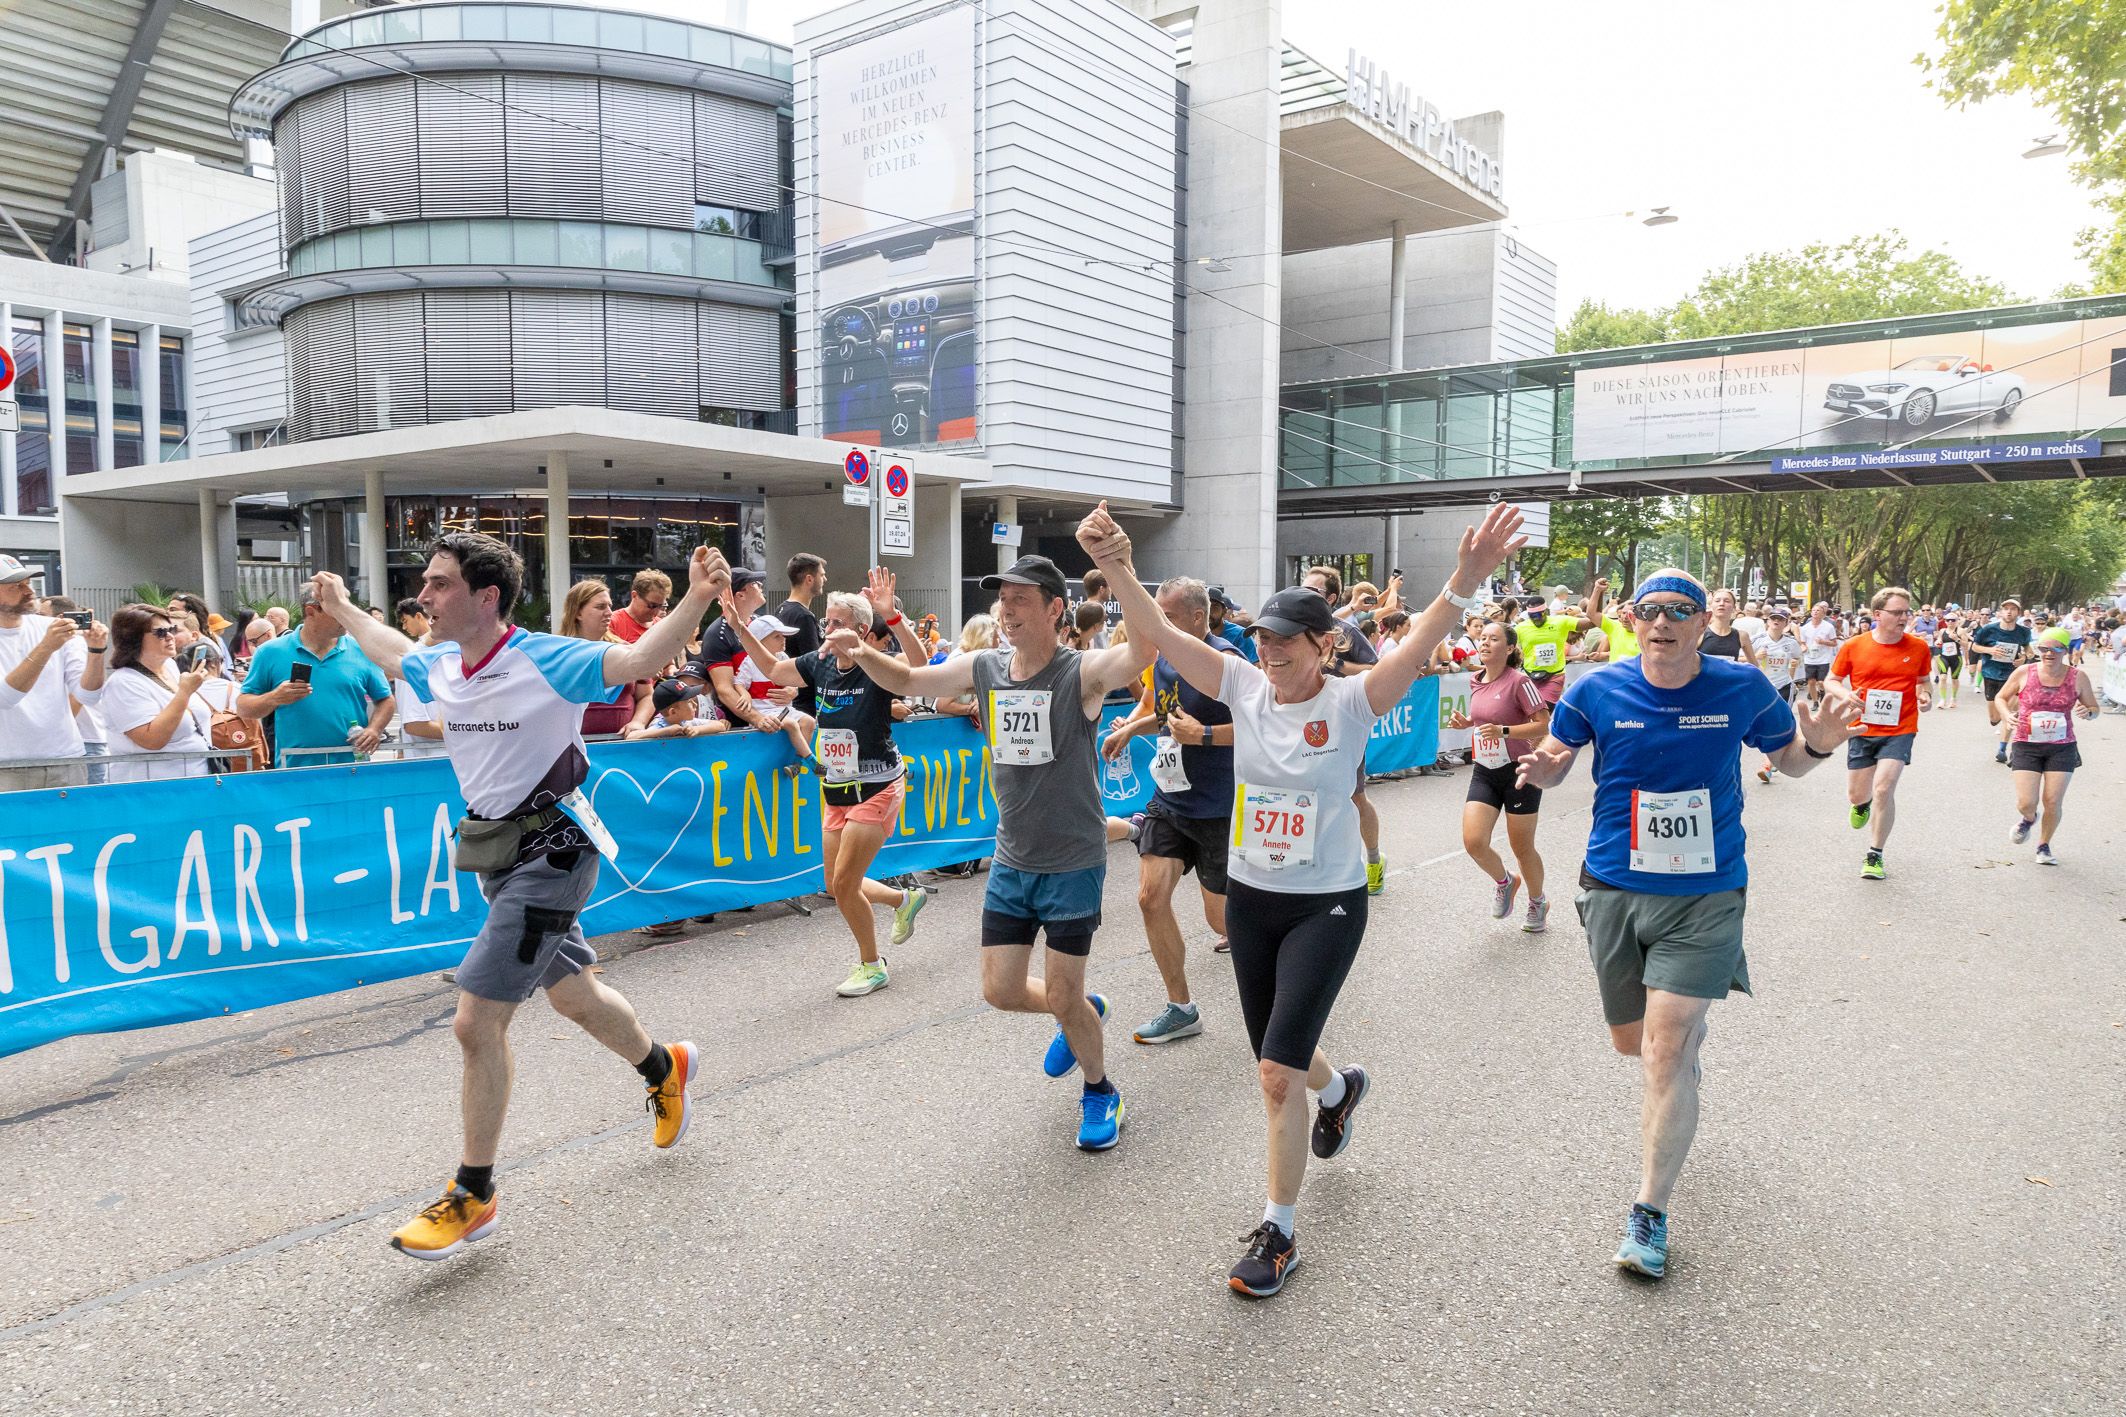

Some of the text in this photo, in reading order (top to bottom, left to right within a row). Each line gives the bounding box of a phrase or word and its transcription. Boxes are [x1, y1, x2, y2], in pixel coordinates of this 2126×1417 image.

[861, 49, 925, 84] HERZLICH
[849, 64, 938, 105] WILLKOMMEN
[861, 90, 927, 122] IM NEUEN
[841, 102, 949, 147] MERCEDES-BENZ
[862, 130, 926, 161] BUSINESS
[1438, 116, 1503, 198] Arena
[867, 152, 921, 178] CENTER.
[1593, 362, 1801, 393] DIESE SAISON ORIENTIEREN
[1616, 381, 1773, 406] WIR UNS NACH OBEN.
[1781, 454, 1857, 470] Mercedes-Benz
[1860, 449, 1937, 466] Niederlassung
[1940, 447, 1991, 464] Stuttgart
[2005, 445, 2029, 458] 250
[2030, 447, 2042, 456] m
[2046, 442, 2088, 456] rechts.
[835, 696, 854, 706] 2023
[1874, 699, 1892, 710] 476
[447, 719, 520, 733] terranets bw
[1003, 711, 1040, 733] 5721
[1614, 719, 1645, 729] Matthias
[1678, 714, 1730, 724] SPORT SCHWAB
[2039, 719, 2058, 730] 477
[824, 743, 852, 758] 5904
[1010, 736, 1035, 745] Andreas
[1478, 738, 1500, 751] 1979
[1253, 809, 1305, 837] 5718
[1647, 814, 1699, 839] 4301
[1262, 838, 1292, 850] Annette
